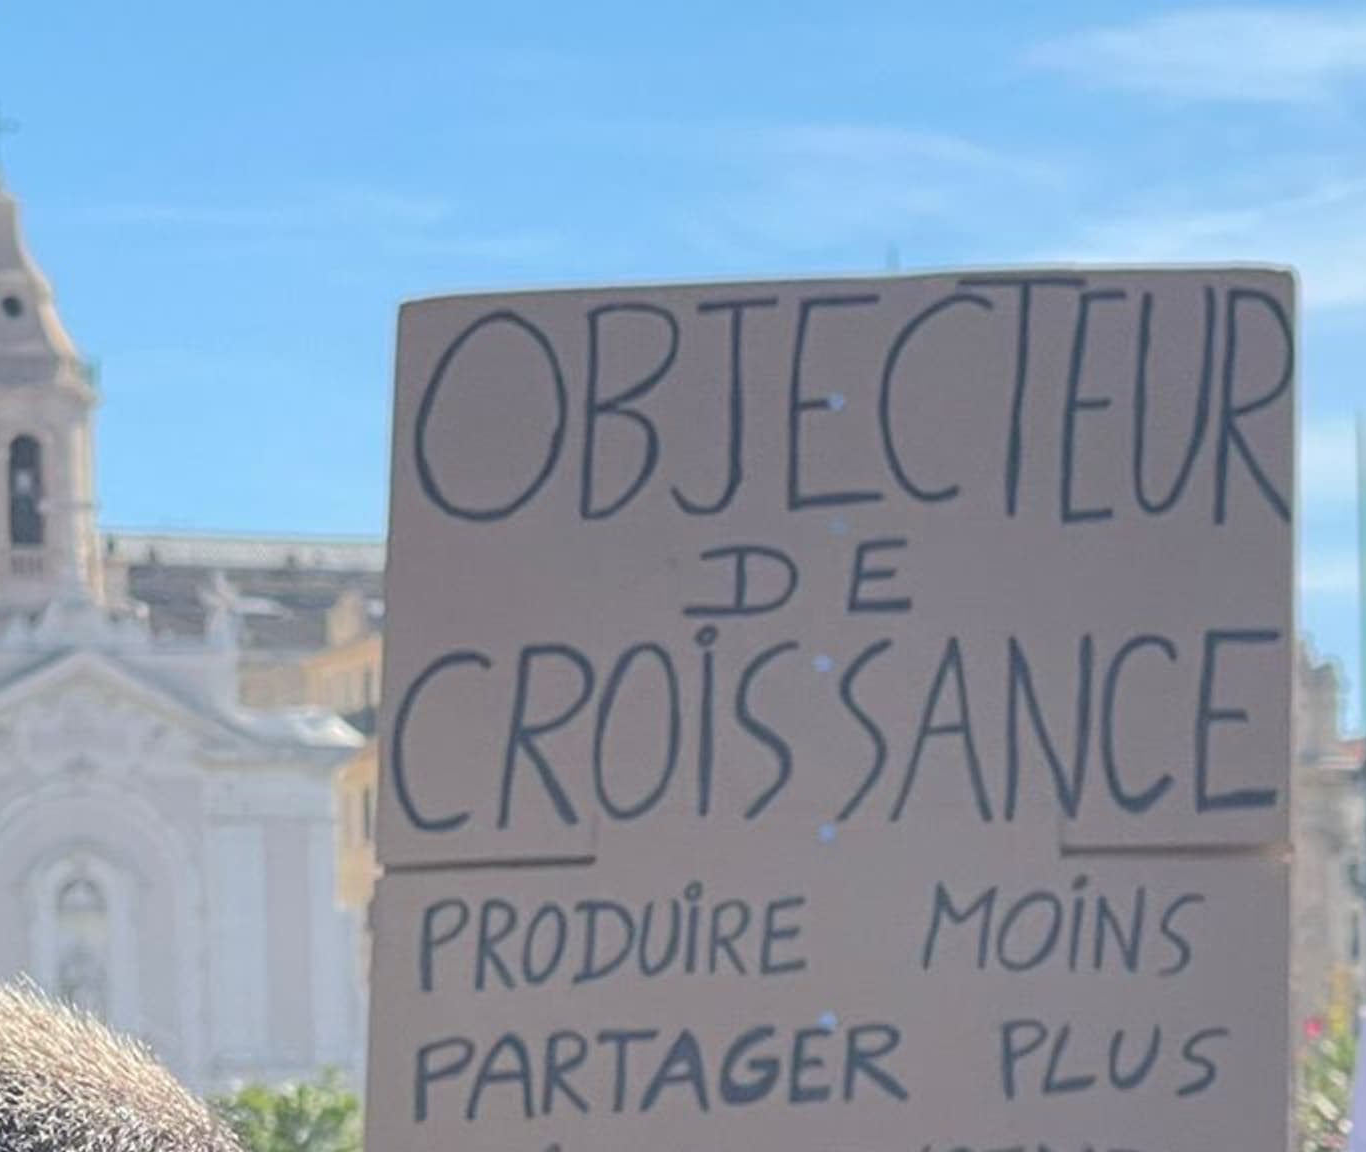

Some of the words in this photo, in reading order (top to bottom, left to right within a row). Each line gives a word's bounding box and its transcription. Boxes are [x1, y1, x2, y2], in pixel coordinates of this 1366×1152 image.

[414, 277, 1293, 524] OBJECTEUR
[683, 539, 912, 617] DE
[392, 627, 1281, 831] CROISSANCE
[420, 882, 806, 991] PRODUIRE
[923, 875, 1203, 974] MOINS
[415, 1025, 907, 1122] PARTAGER
[1001, 1020, 1227, 1099] PLUS
